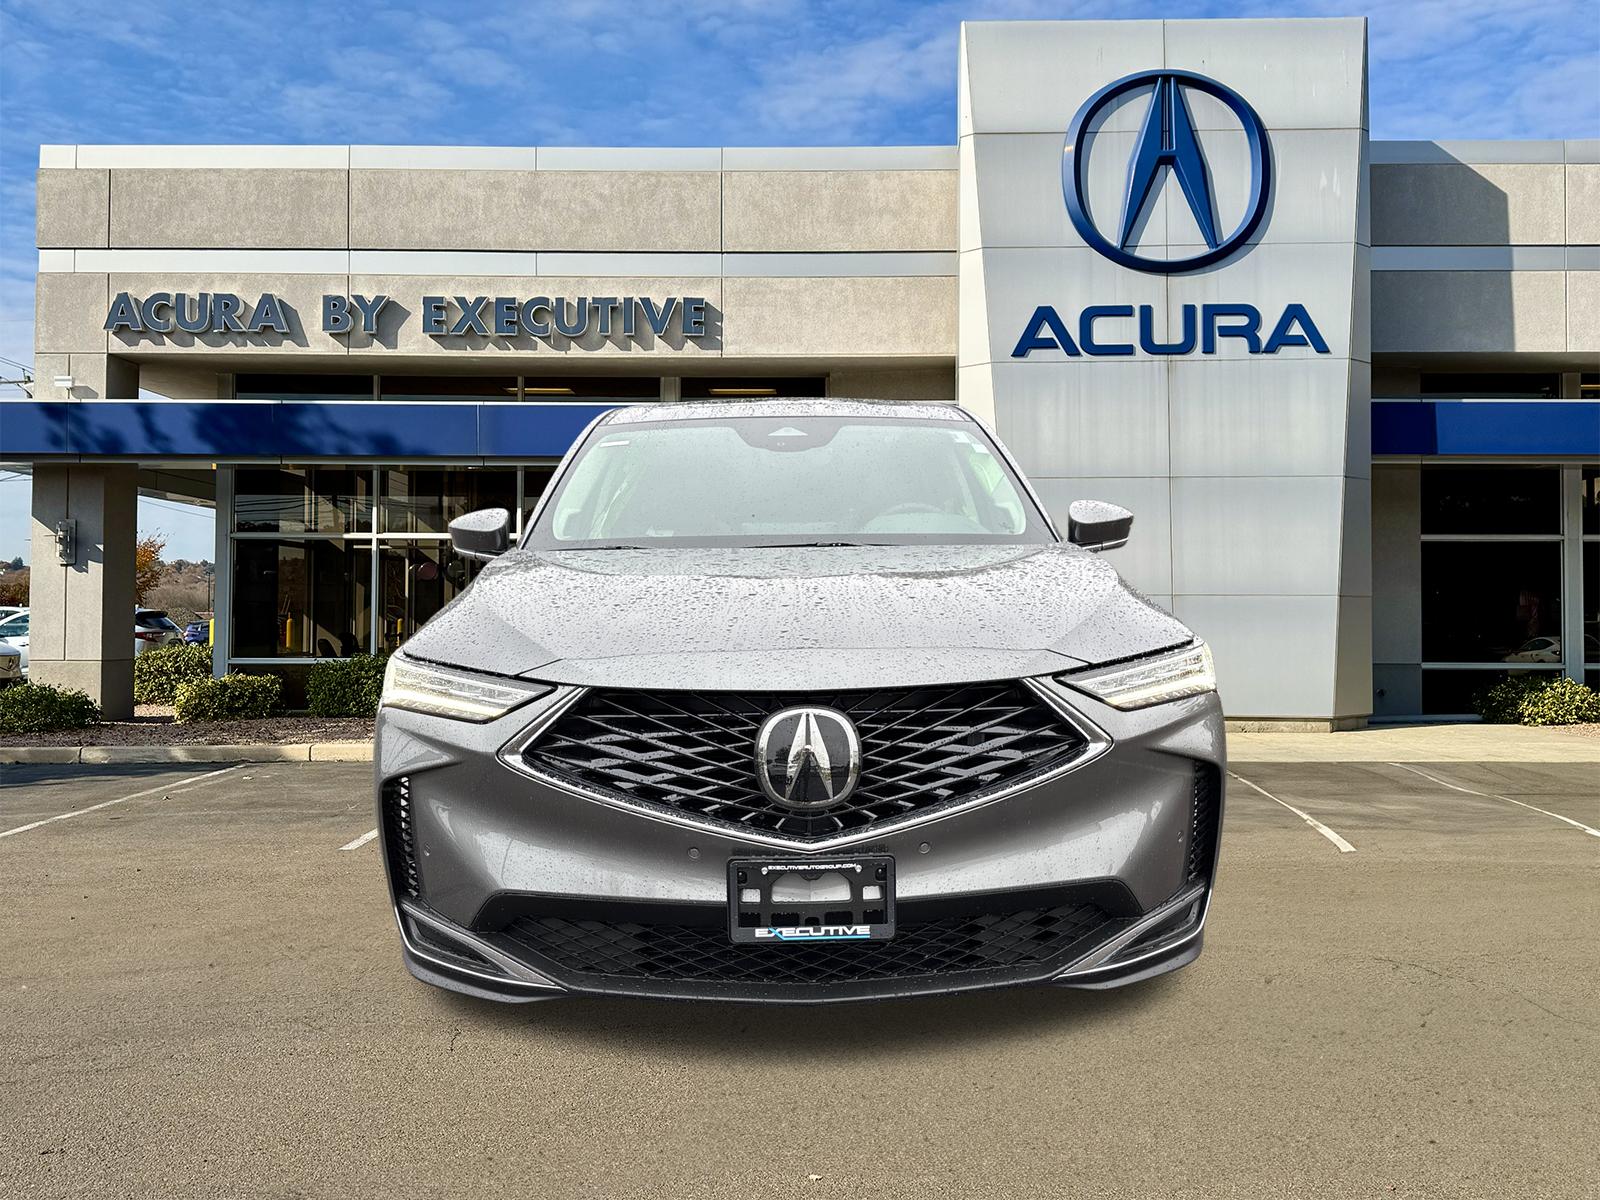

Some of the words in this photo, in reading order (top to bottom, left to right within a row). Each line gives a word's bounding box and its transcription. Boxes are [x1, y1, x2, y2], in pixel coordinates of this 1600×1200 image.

[103, 292, 290, 334] ACURA
[322, 294, 391, 334] BY
[422, 295, 706, 336] EXECUTIVE
[1010, 303, 1331, 358] ACURA
[755, 926, 870, 939] EXECUTIVE
